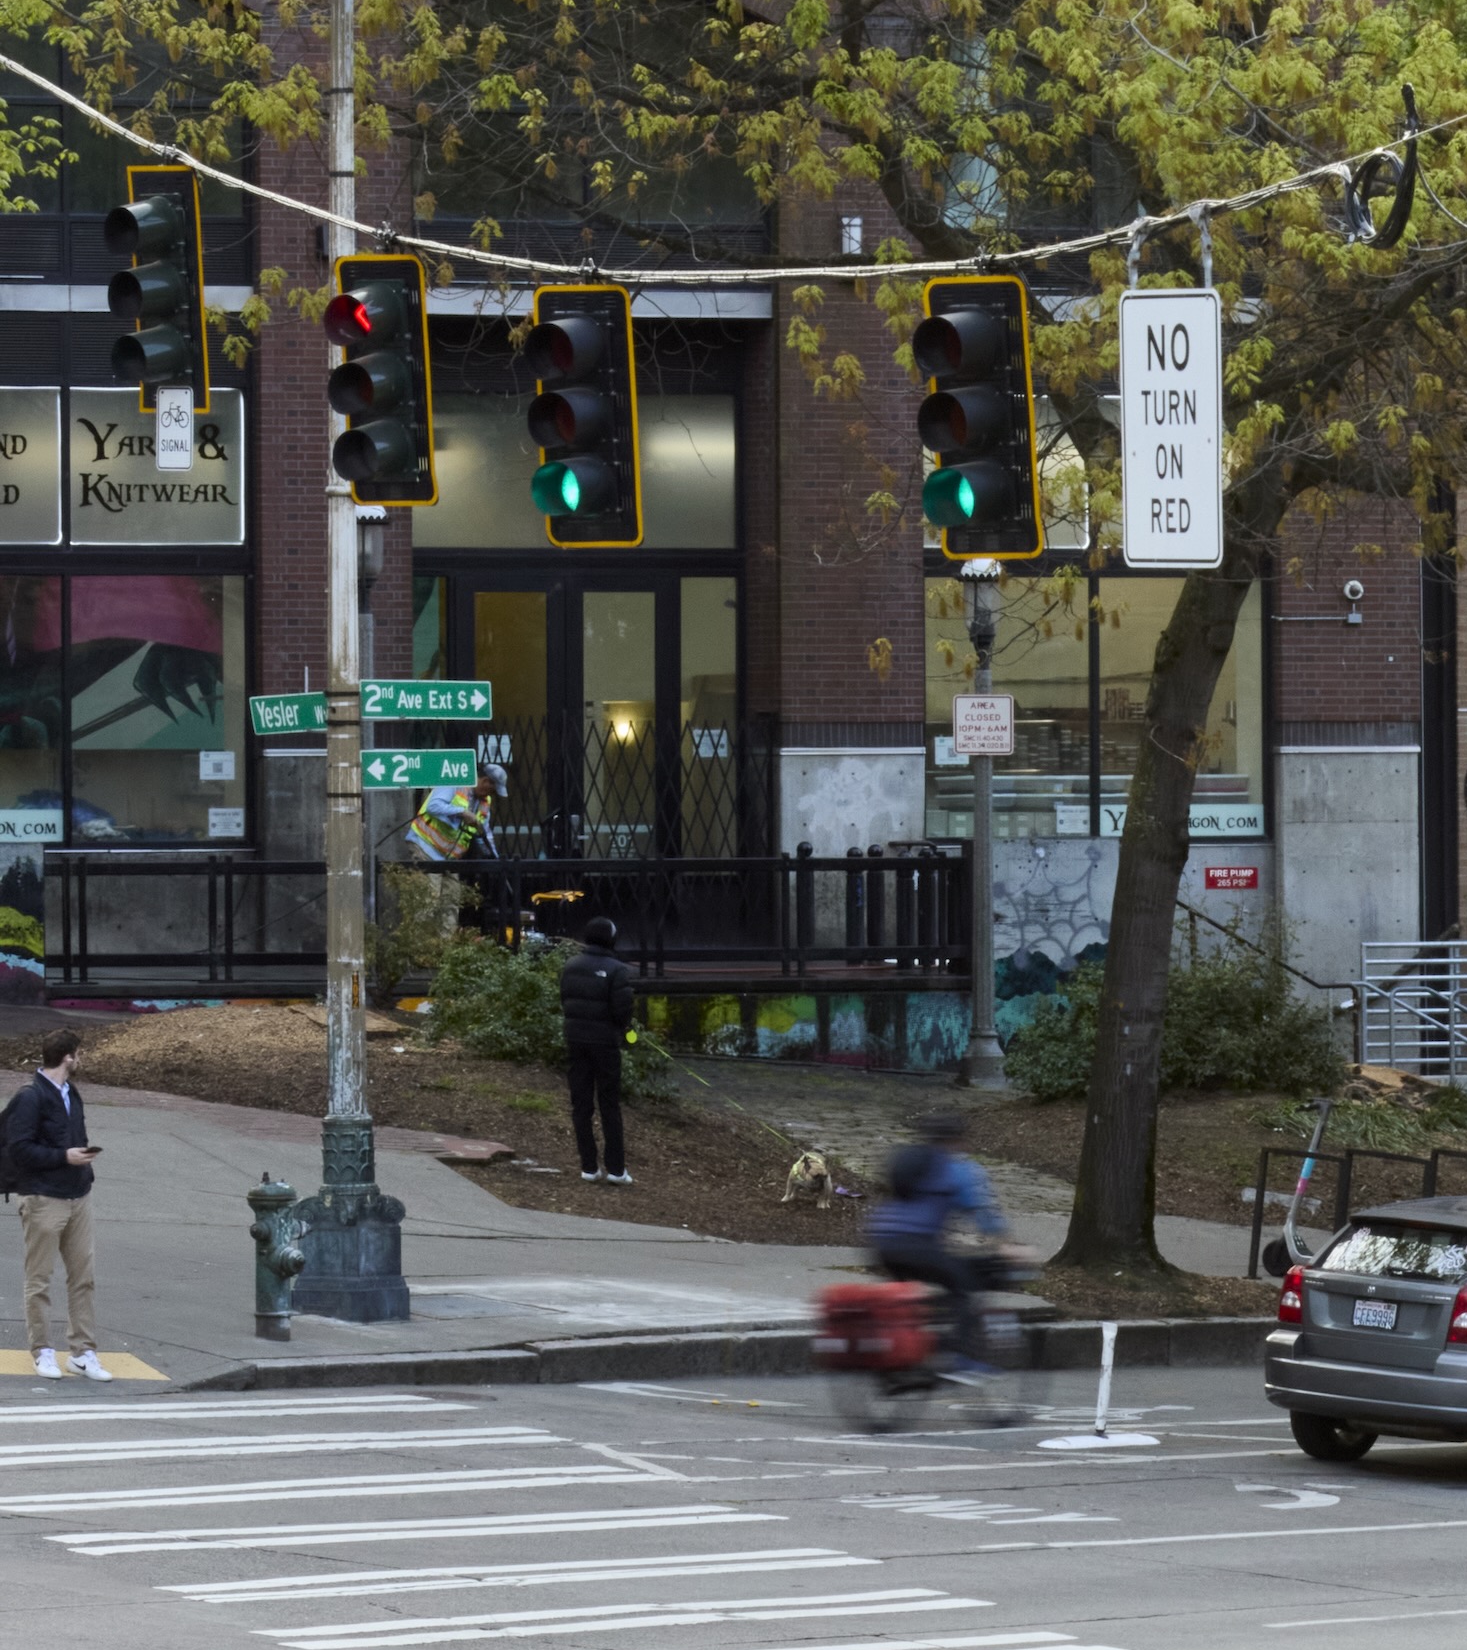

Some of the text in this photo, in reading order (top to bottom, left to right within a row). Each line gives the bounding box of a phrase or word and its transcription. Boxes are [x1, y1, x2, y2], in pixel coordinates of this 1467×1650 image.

[1147, 323, 1190, 371] NO
[1141, 390, 1196, 425] TURN
[77, 418, 228, 462] YAR &
[160, 439, 190, 452] SIGNAL
[1156, 444, 1183, 479] ON
[79, 473, 238, 513] KNITWEAR
[1151, 498, 1191, 533] RED
[364, 684, 467, 712] 2nd Ave Ext S
[971, 702, 995, 710] AREA
[256, 701, 299, 728] Yesler
[964, 714, 1001, 722] CLOSED
[392, 755, 468, 782] 2nd Ave
[1209, 869, 1254, 877] FIRE PUMP
